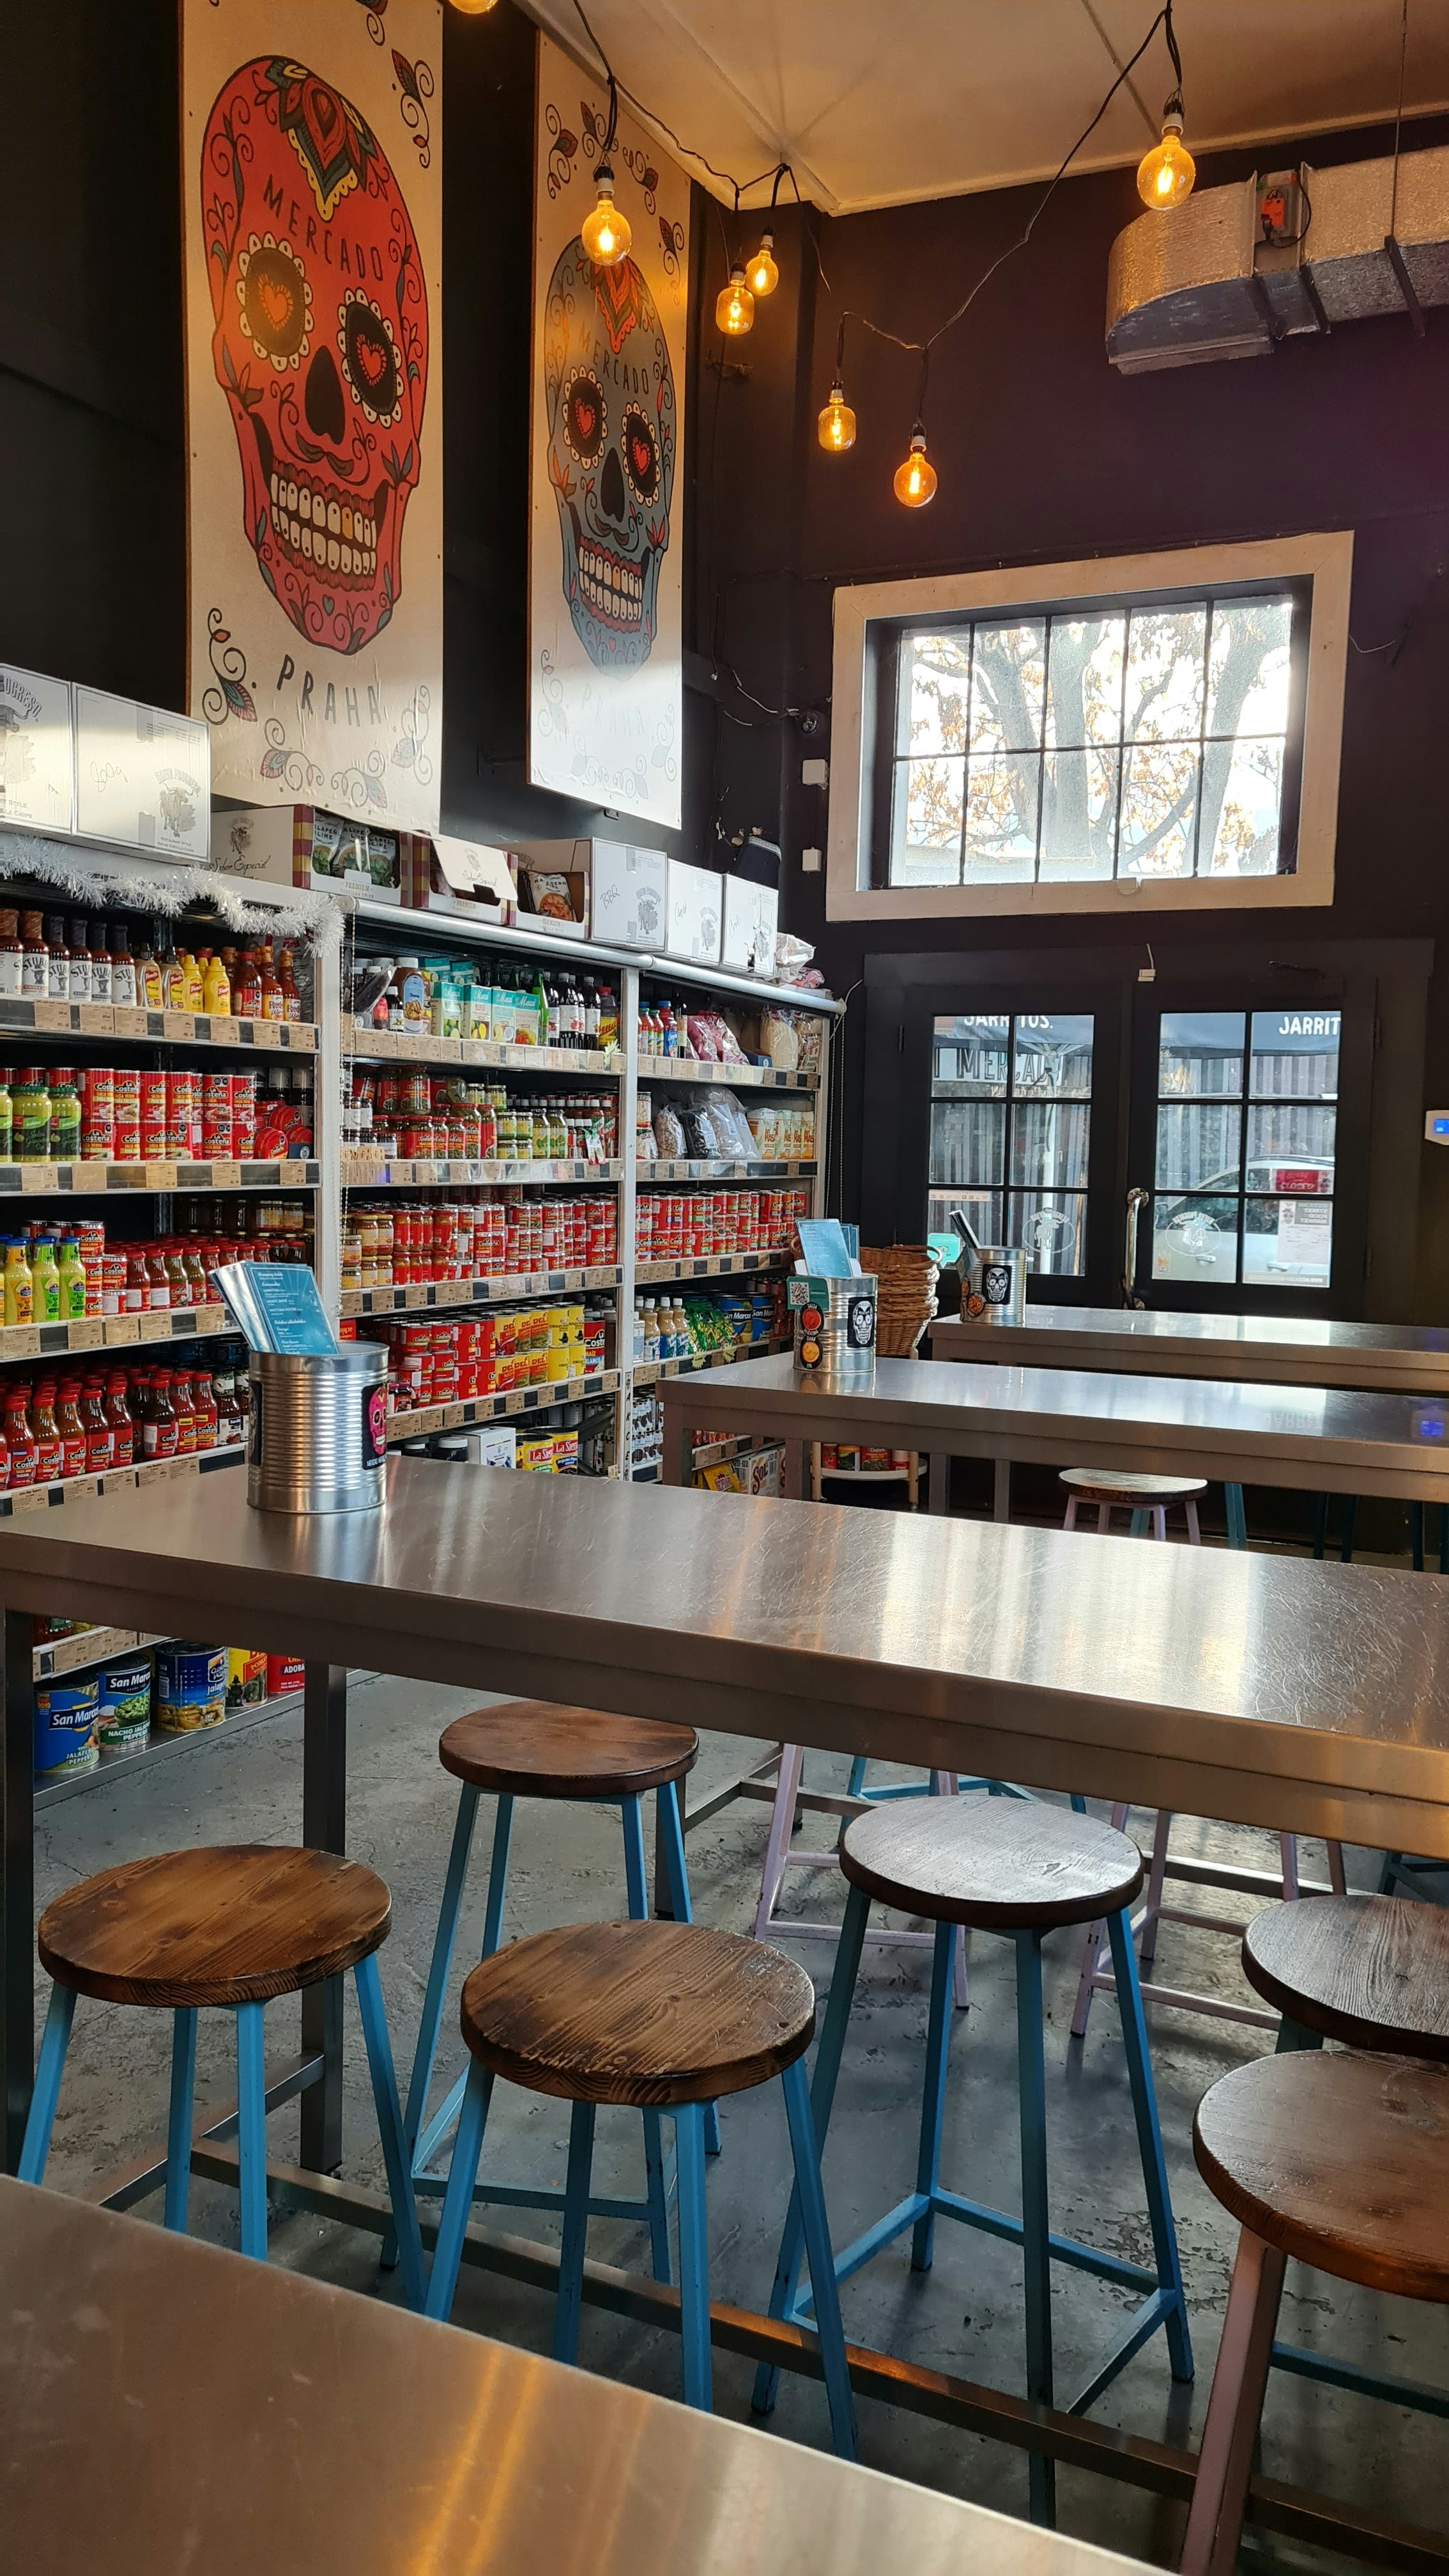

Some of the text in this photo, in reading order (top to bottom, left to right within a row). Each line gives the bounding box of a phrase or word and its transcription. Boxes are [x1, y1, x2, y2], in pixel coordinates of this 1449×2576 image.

[263, 174, 383, 281] MERCADO
[579, 319, 649, 395] MERCADO
[276, 654, 382, 727] PRAHA
[345, 881, 370, 892] PREMIUM
[963, 1016, 1054, 1029] JARRTOS.
[555, 1443, 565, 1453] La
[110, 1676, 130, 1689] San
[52, 1713, 73, 1726] San
[108, 1729, 133, 1737] NACHO
[123, 1729, 148, 1741] PEPPERS
[68, 1754, 93, 1765] PEPPERS
